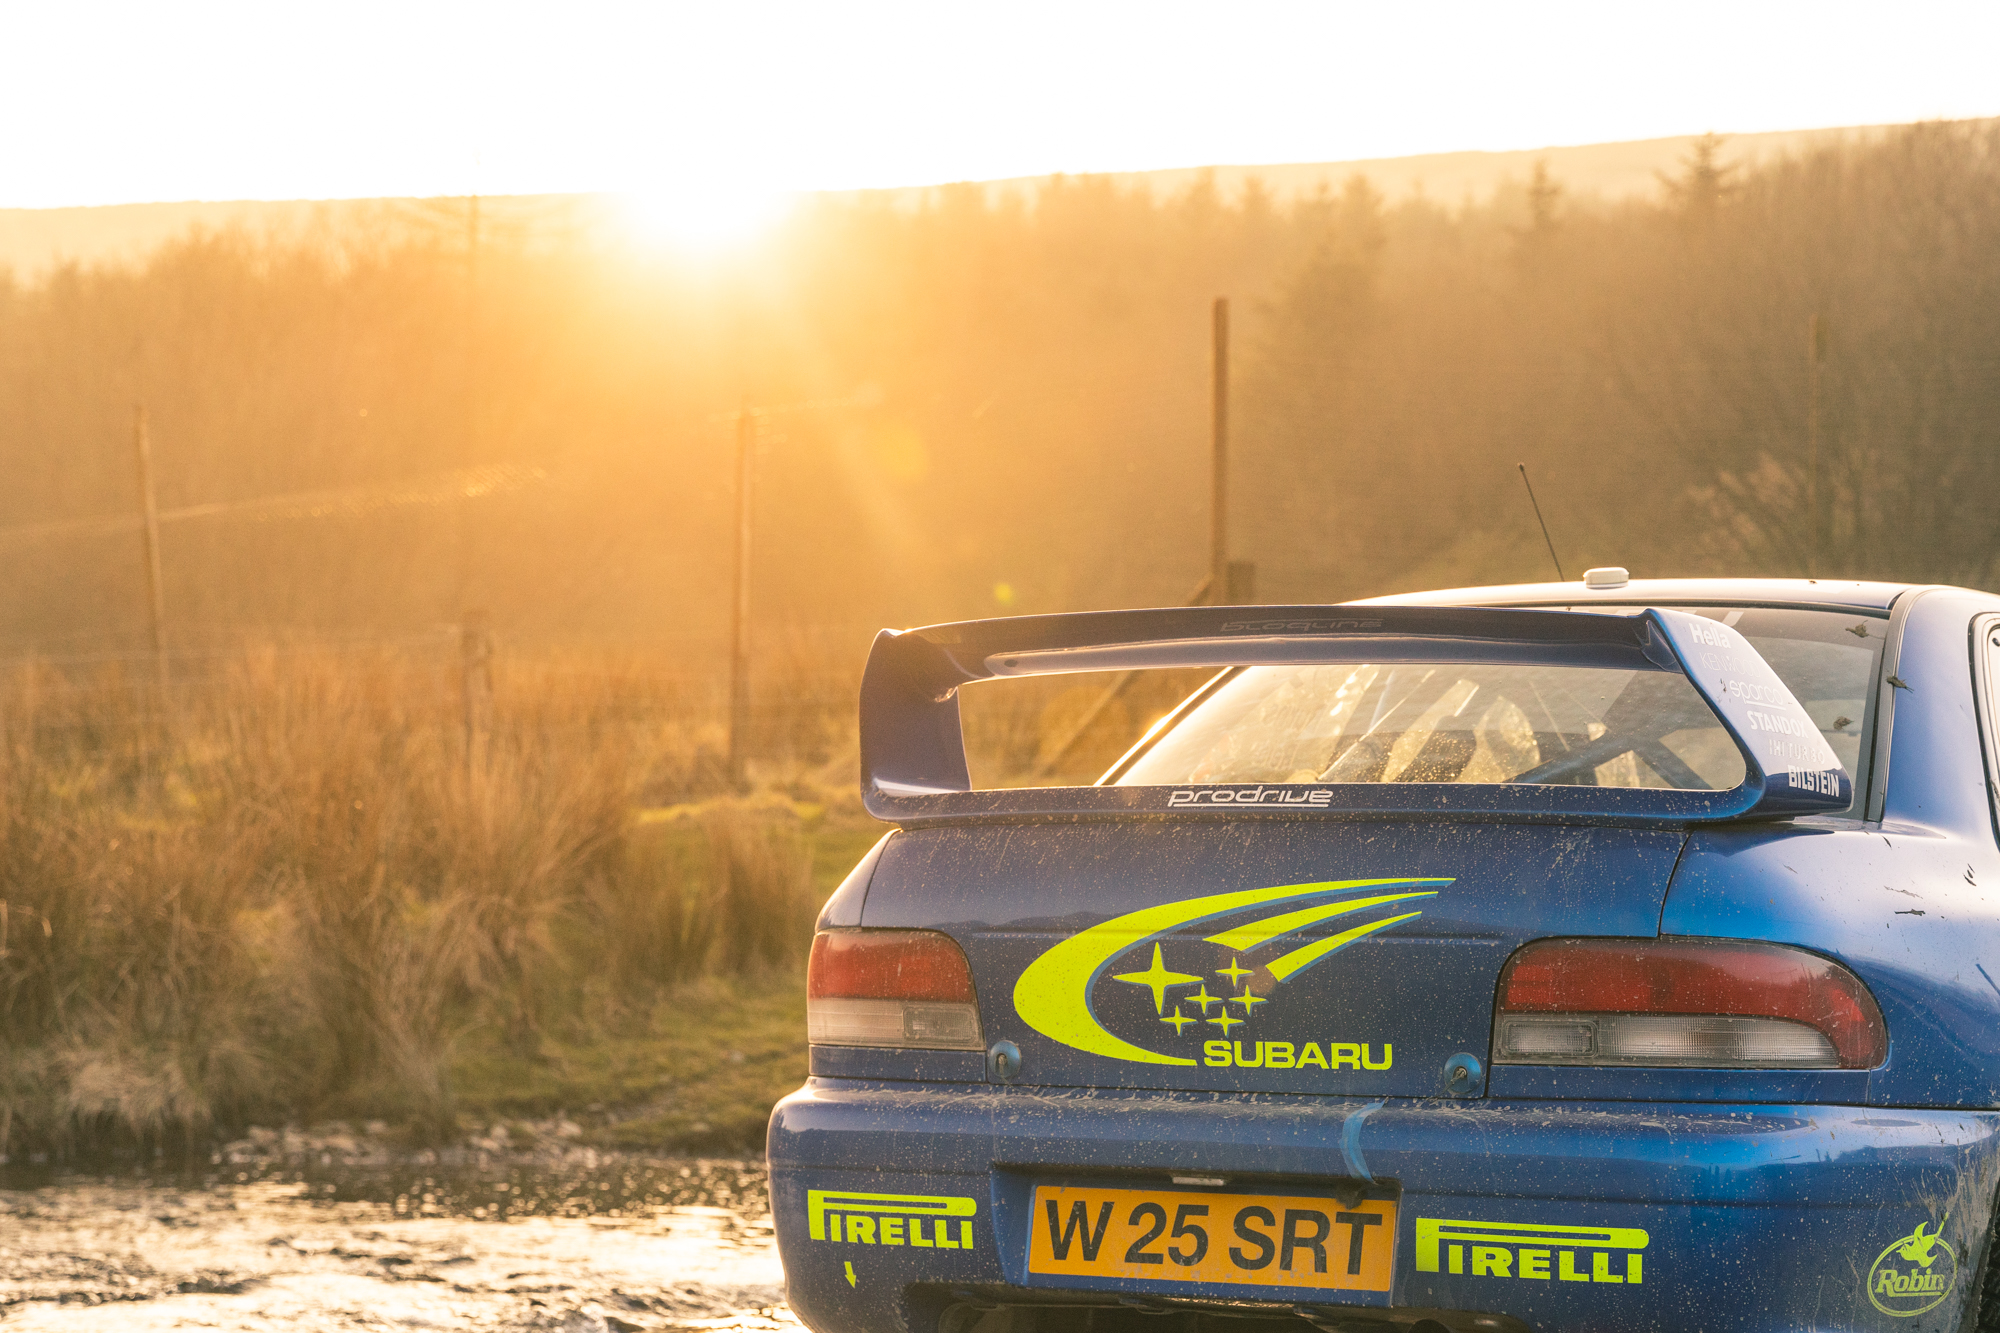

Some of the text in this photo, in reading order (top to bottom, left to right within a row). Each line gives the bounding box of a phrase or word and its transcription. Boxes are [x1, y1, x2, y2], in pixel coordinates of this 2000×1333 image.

[1689, 622, 1731, 649] Hella
[1700, 652, 1761, 678] KENWOOD
[1729, 680, 1785, 708] sparco
[1746, 711, 1809, 739] STANDOX
[1788, 765, 1840, 798] BILSTEIN
[1167, 786, 1334, 808] prodrive
[1203, 1040, 1393, 1070] SUBARU
[807, 1189, 977, 1250] PIRELLI
[1045, 1200, 1383, 1276] W 25 SRT
[1416, 1217, 1650, 1284] PIRELLI
[1875, 1268, 1945, 1298] Robin
